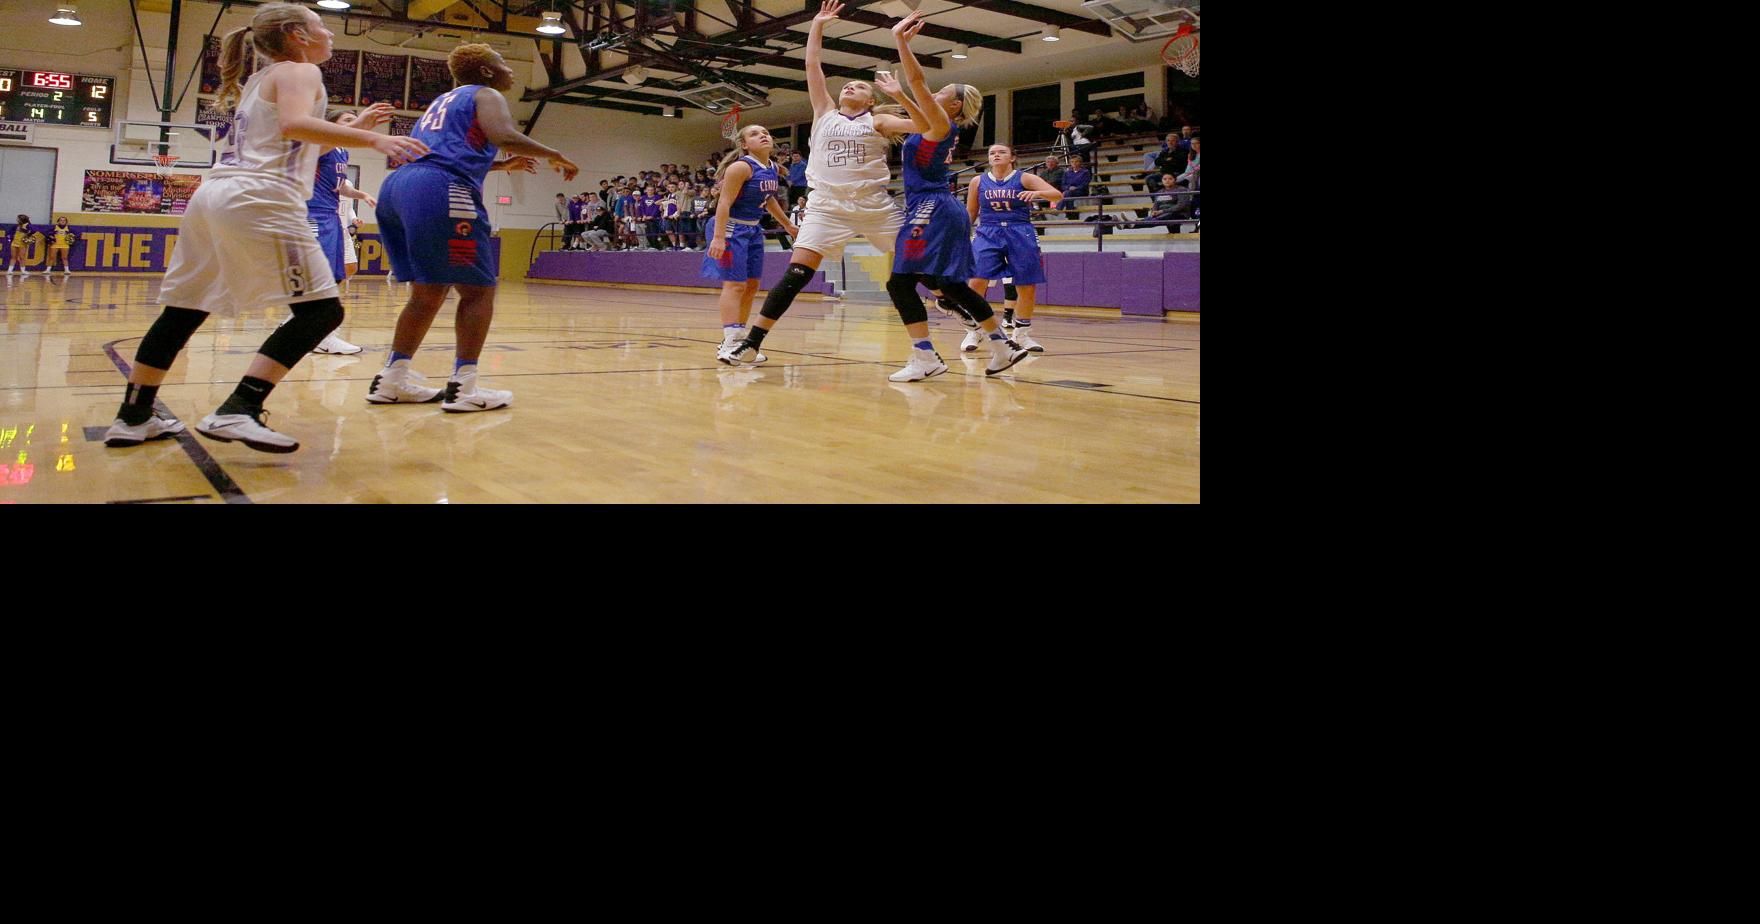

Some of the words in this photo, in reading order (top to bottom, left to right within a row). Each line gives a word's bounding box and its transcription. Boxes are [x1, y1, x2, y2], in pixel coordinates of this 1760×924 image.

[33, 73, 71, 88] 6:55
[53, 91, 63, 101] 2
[91, 85, 107, 99] 12
[30, 108, 44, 118] 14
[57, 109, 62, 120] 1
[88, 112, 97, 122] 5
[420, 94, 458, 132] 45
[827, 139, 866, 168] 24
[985, 190, 1016, 199] CENTRAL
[990, 201, 1011, 211] 21
[81, 232, 152, 268] THE
[287, 264, 305, 292] S
